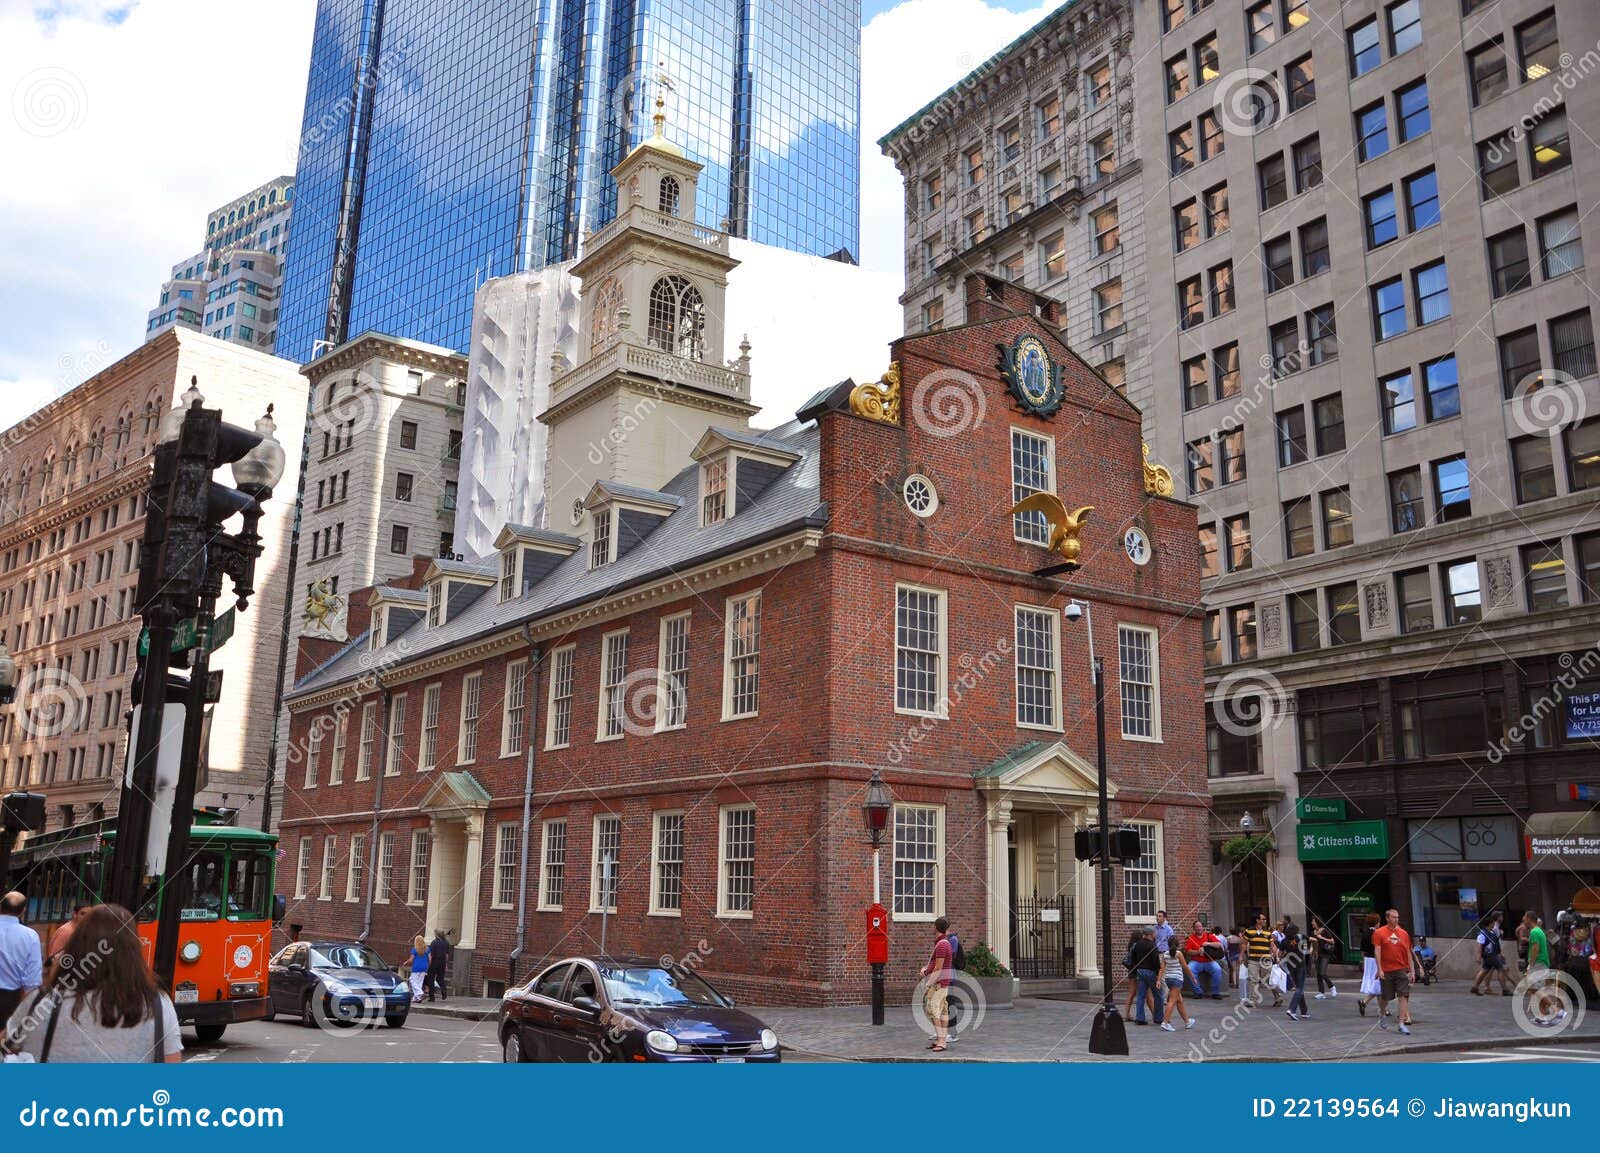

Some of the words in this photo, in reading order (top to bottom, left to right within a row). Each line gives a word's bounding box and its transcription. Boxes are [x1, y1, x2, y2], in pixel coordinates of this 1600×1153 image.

[1568, 695, 1590, 704] This
[1572, 706, 1587, 716] for
[1317, 836, 1353, 847] Citizens
[1354, 834, 1378, 845] Bank
[1532, 837, 1576, 845] American
[1532, 846, 1560, 854] Travel
